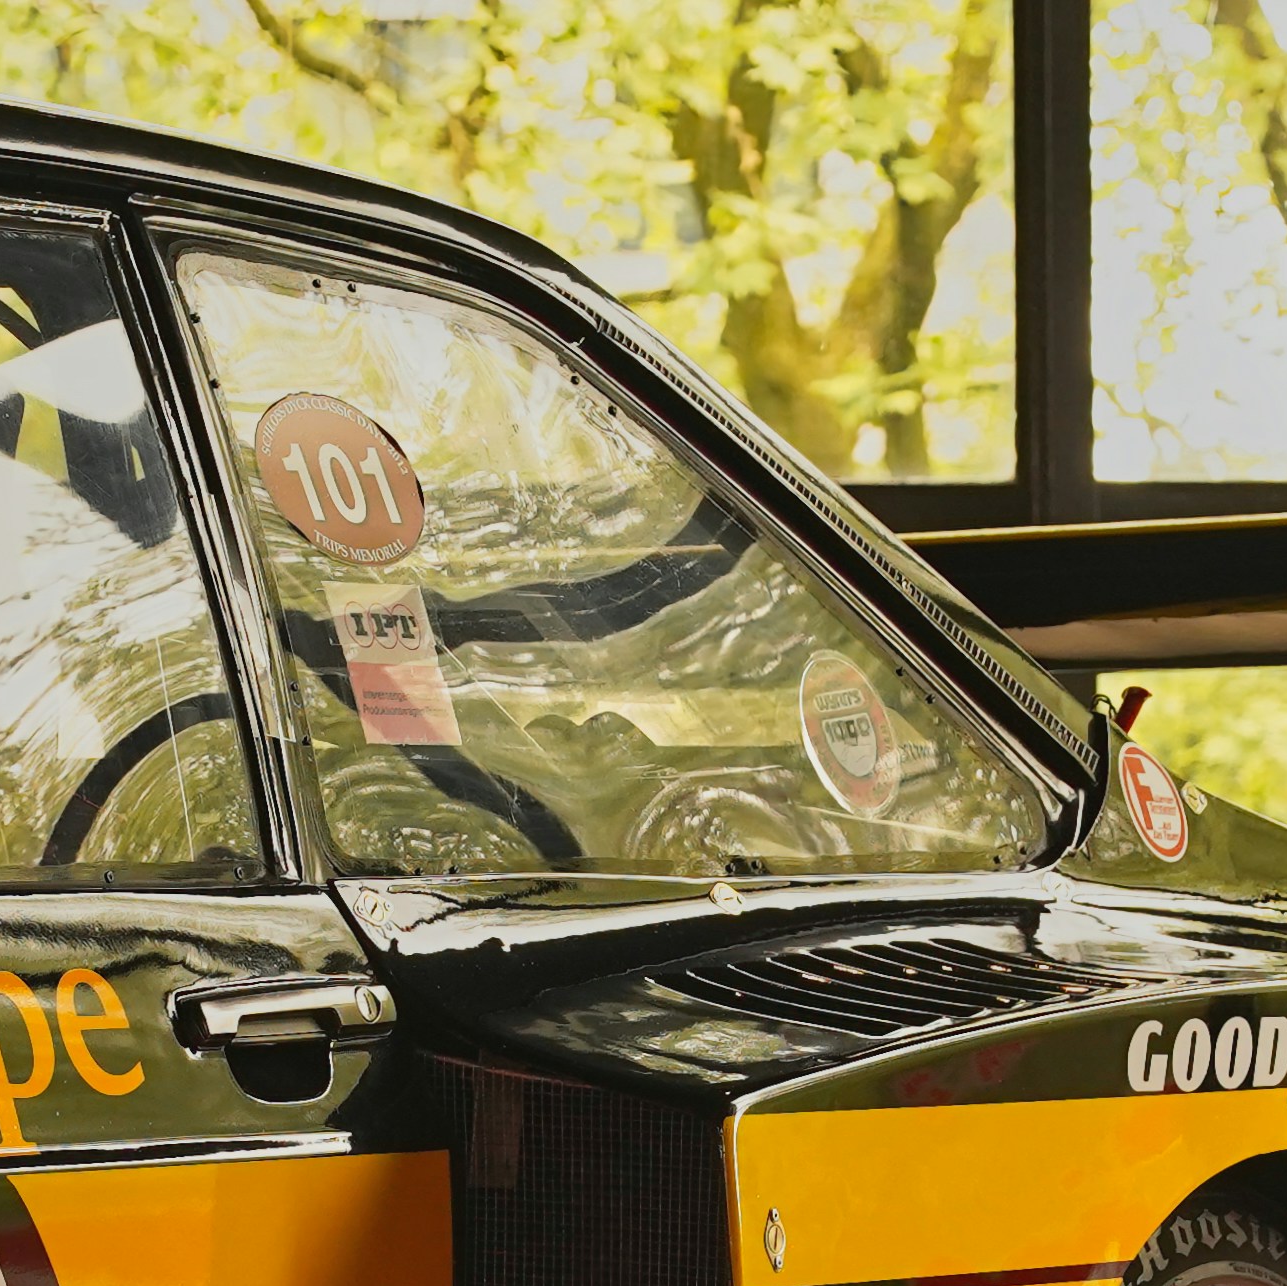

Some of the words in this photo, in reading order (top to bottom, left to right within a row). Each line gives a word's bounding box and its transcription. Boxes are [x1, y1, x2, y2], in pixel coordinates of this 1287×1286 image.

[282, 443, 402, 524] 101
[314, 529, 349, 558] TRIPS
[348, 538, 408, 562] MEMORIAL
[350, 612, 417, 640] IPT
